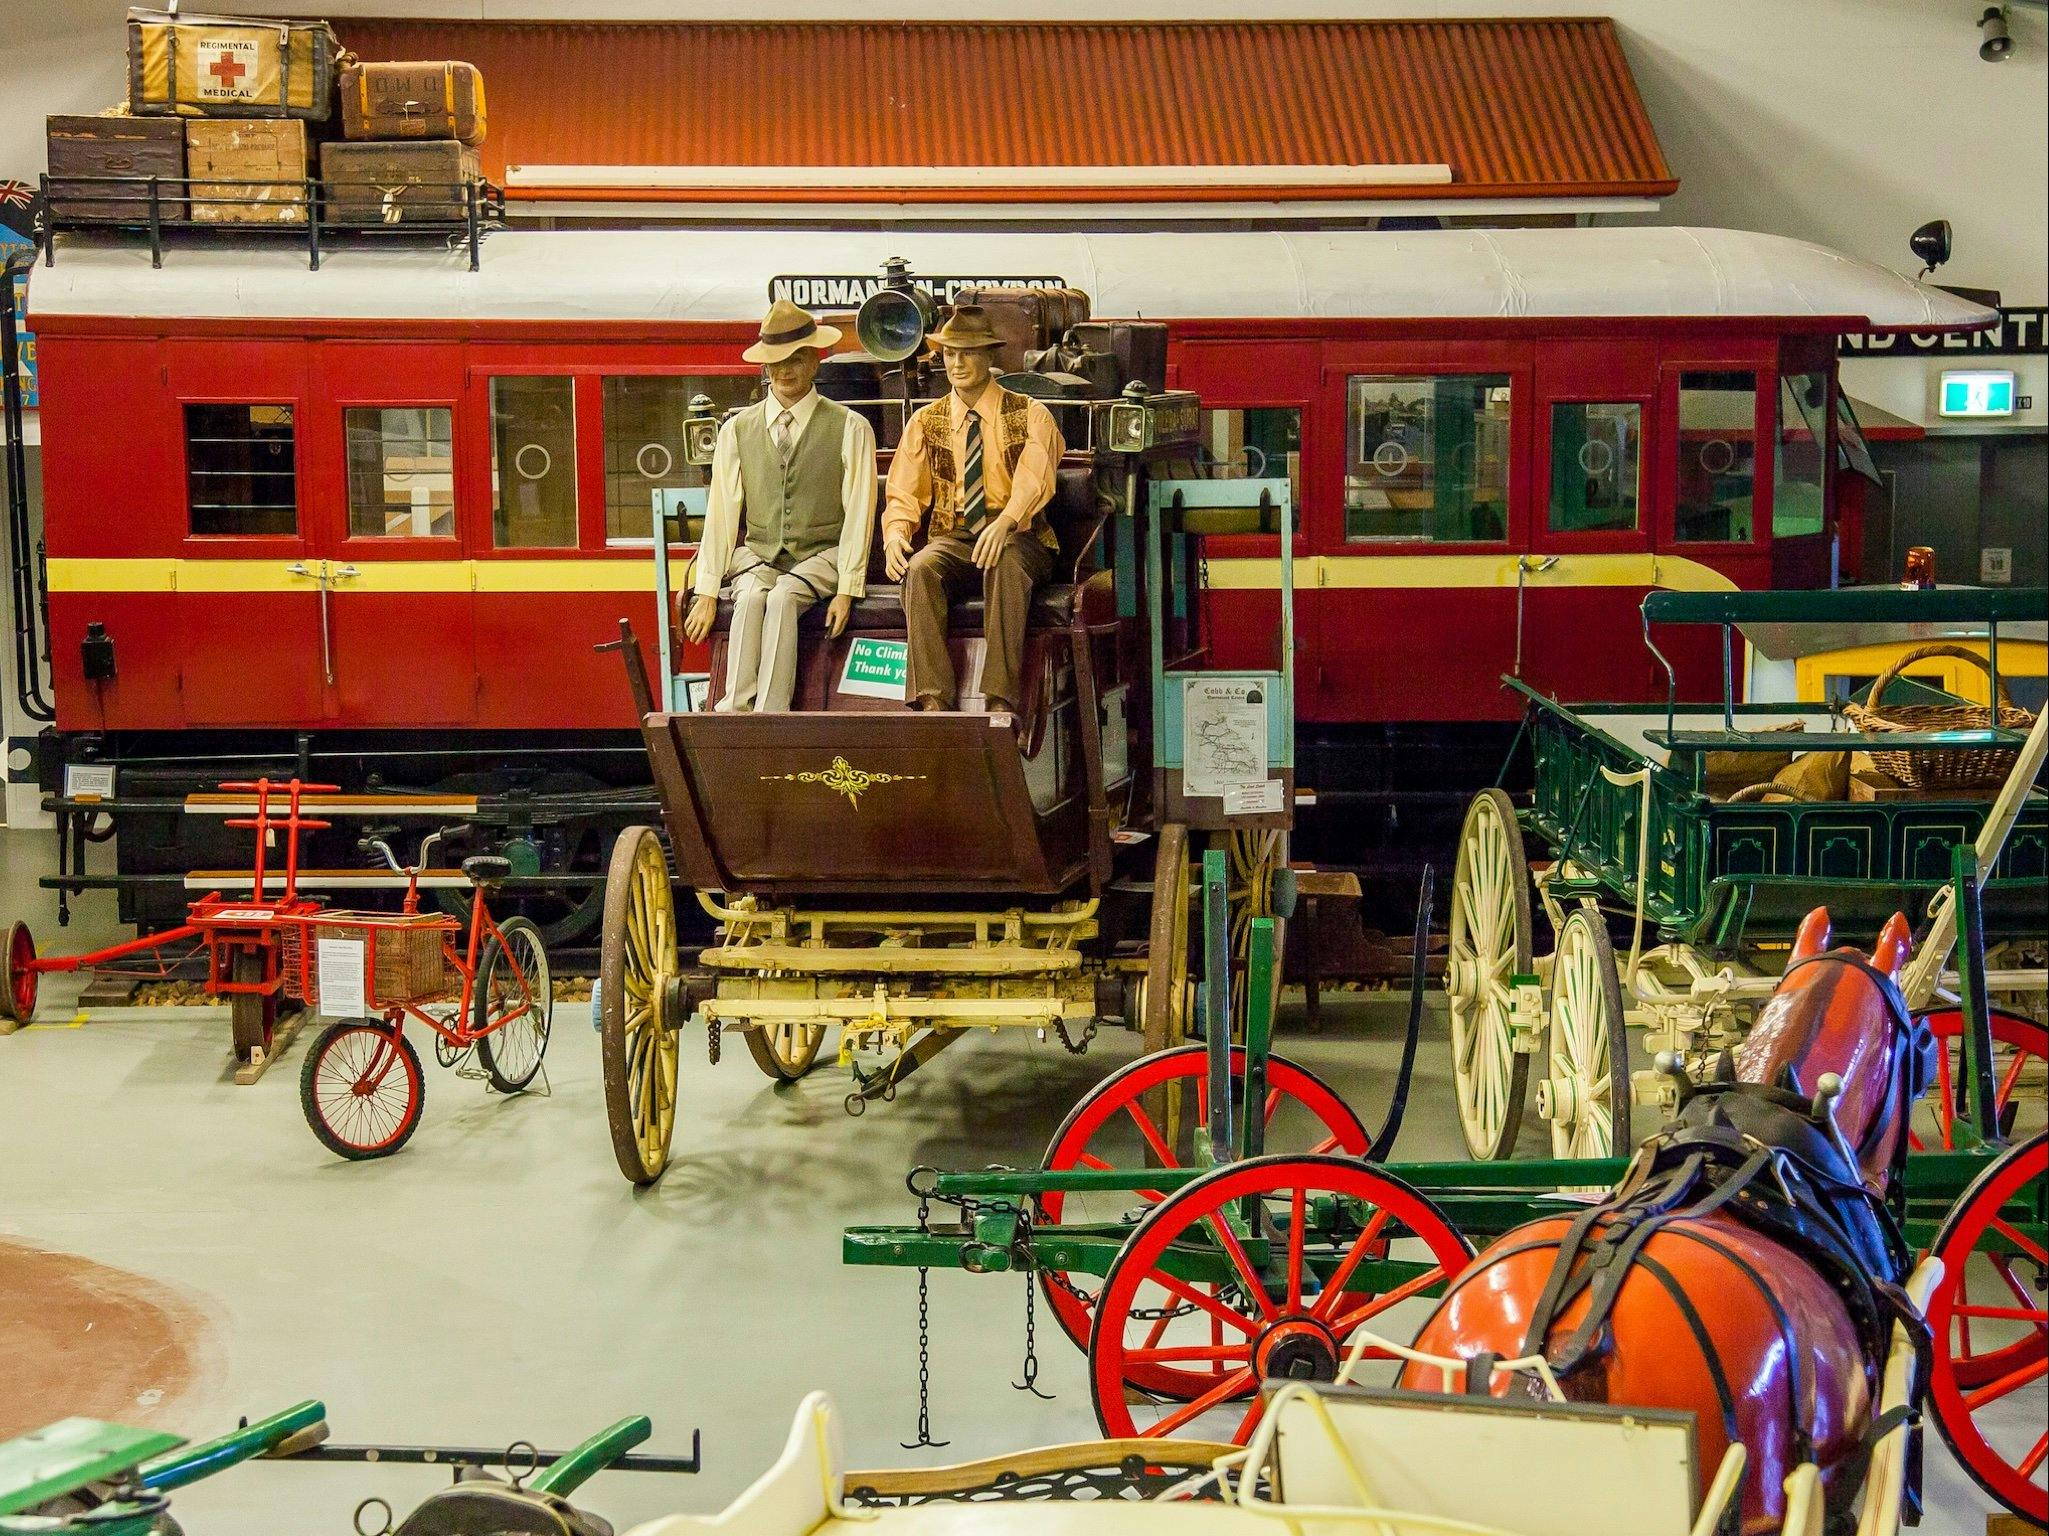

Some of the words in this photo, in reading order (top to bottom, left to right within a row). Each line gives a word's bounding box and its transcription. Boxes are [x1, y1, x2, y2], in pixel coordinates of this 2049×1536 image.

[200, 41, 255, 51] REGIMENTAL
[203, 88, 253, 98] MEDICAL
[854, 644, 872, 656] No
[875, 646, 908, 661] Climb
[854, 661, 892, 676] Thank
[893, 668, 907, 680] yo
